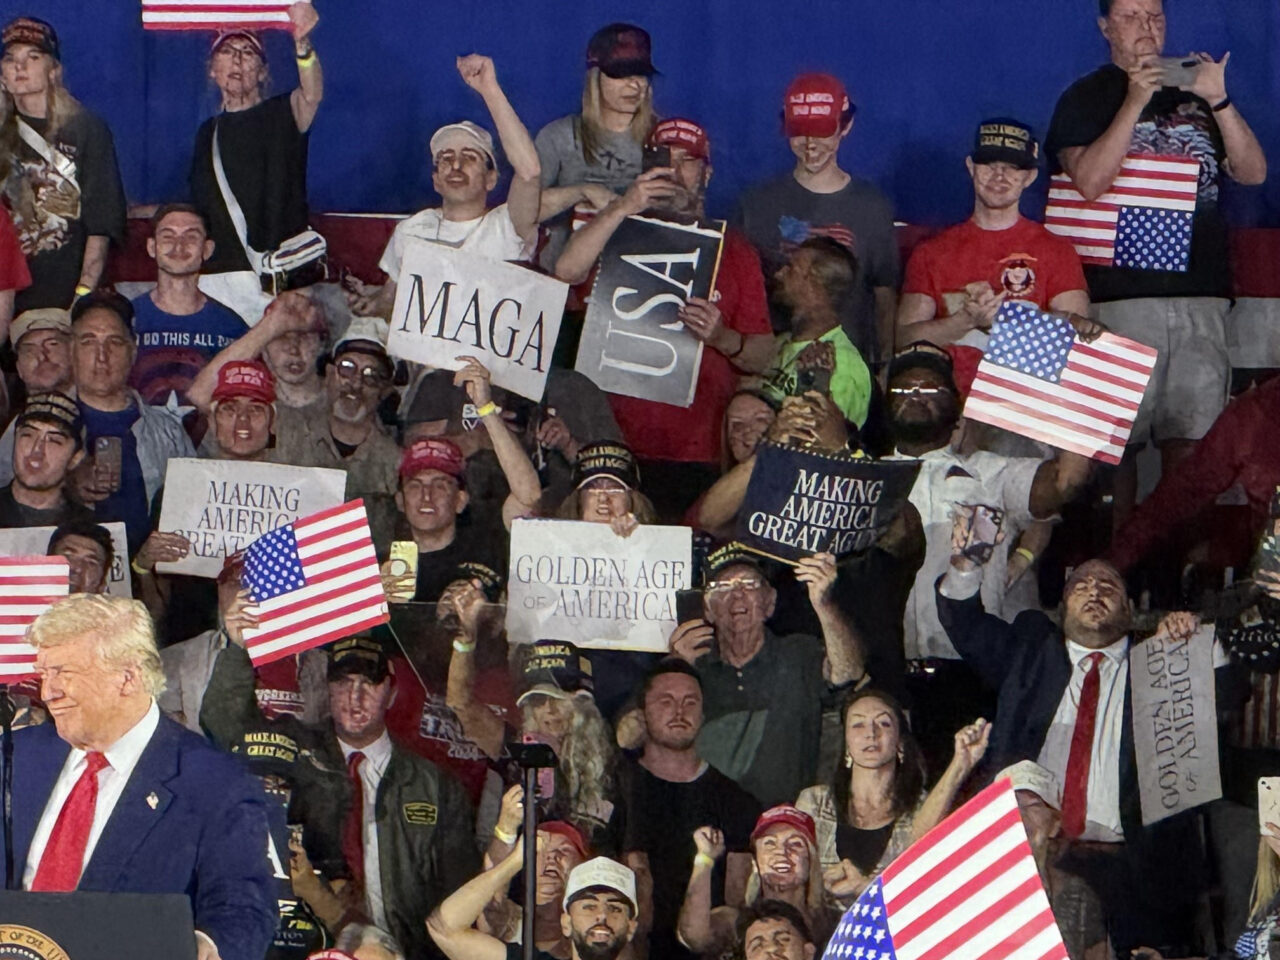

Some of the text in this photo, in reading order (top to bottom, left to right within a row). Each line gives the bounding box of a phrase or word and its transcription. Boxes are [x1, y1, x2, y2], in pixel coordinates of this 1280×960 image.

[397, 274, 545, 373] MAGA
[599, 248, 700, 376] USA
[162, 332, 190, 345] THIS
[193, 334, 214, 346] ALL
[208, 481, 300, 512] MAKING
[793, 469, 884, 504] MAKING
[749, 511, 828, 552] GREAT
[516, 554, 628, 588] GOLDEN
[634, 559, 685, 590] AGE
[523, 590, 677, 622] OF AMERICA
